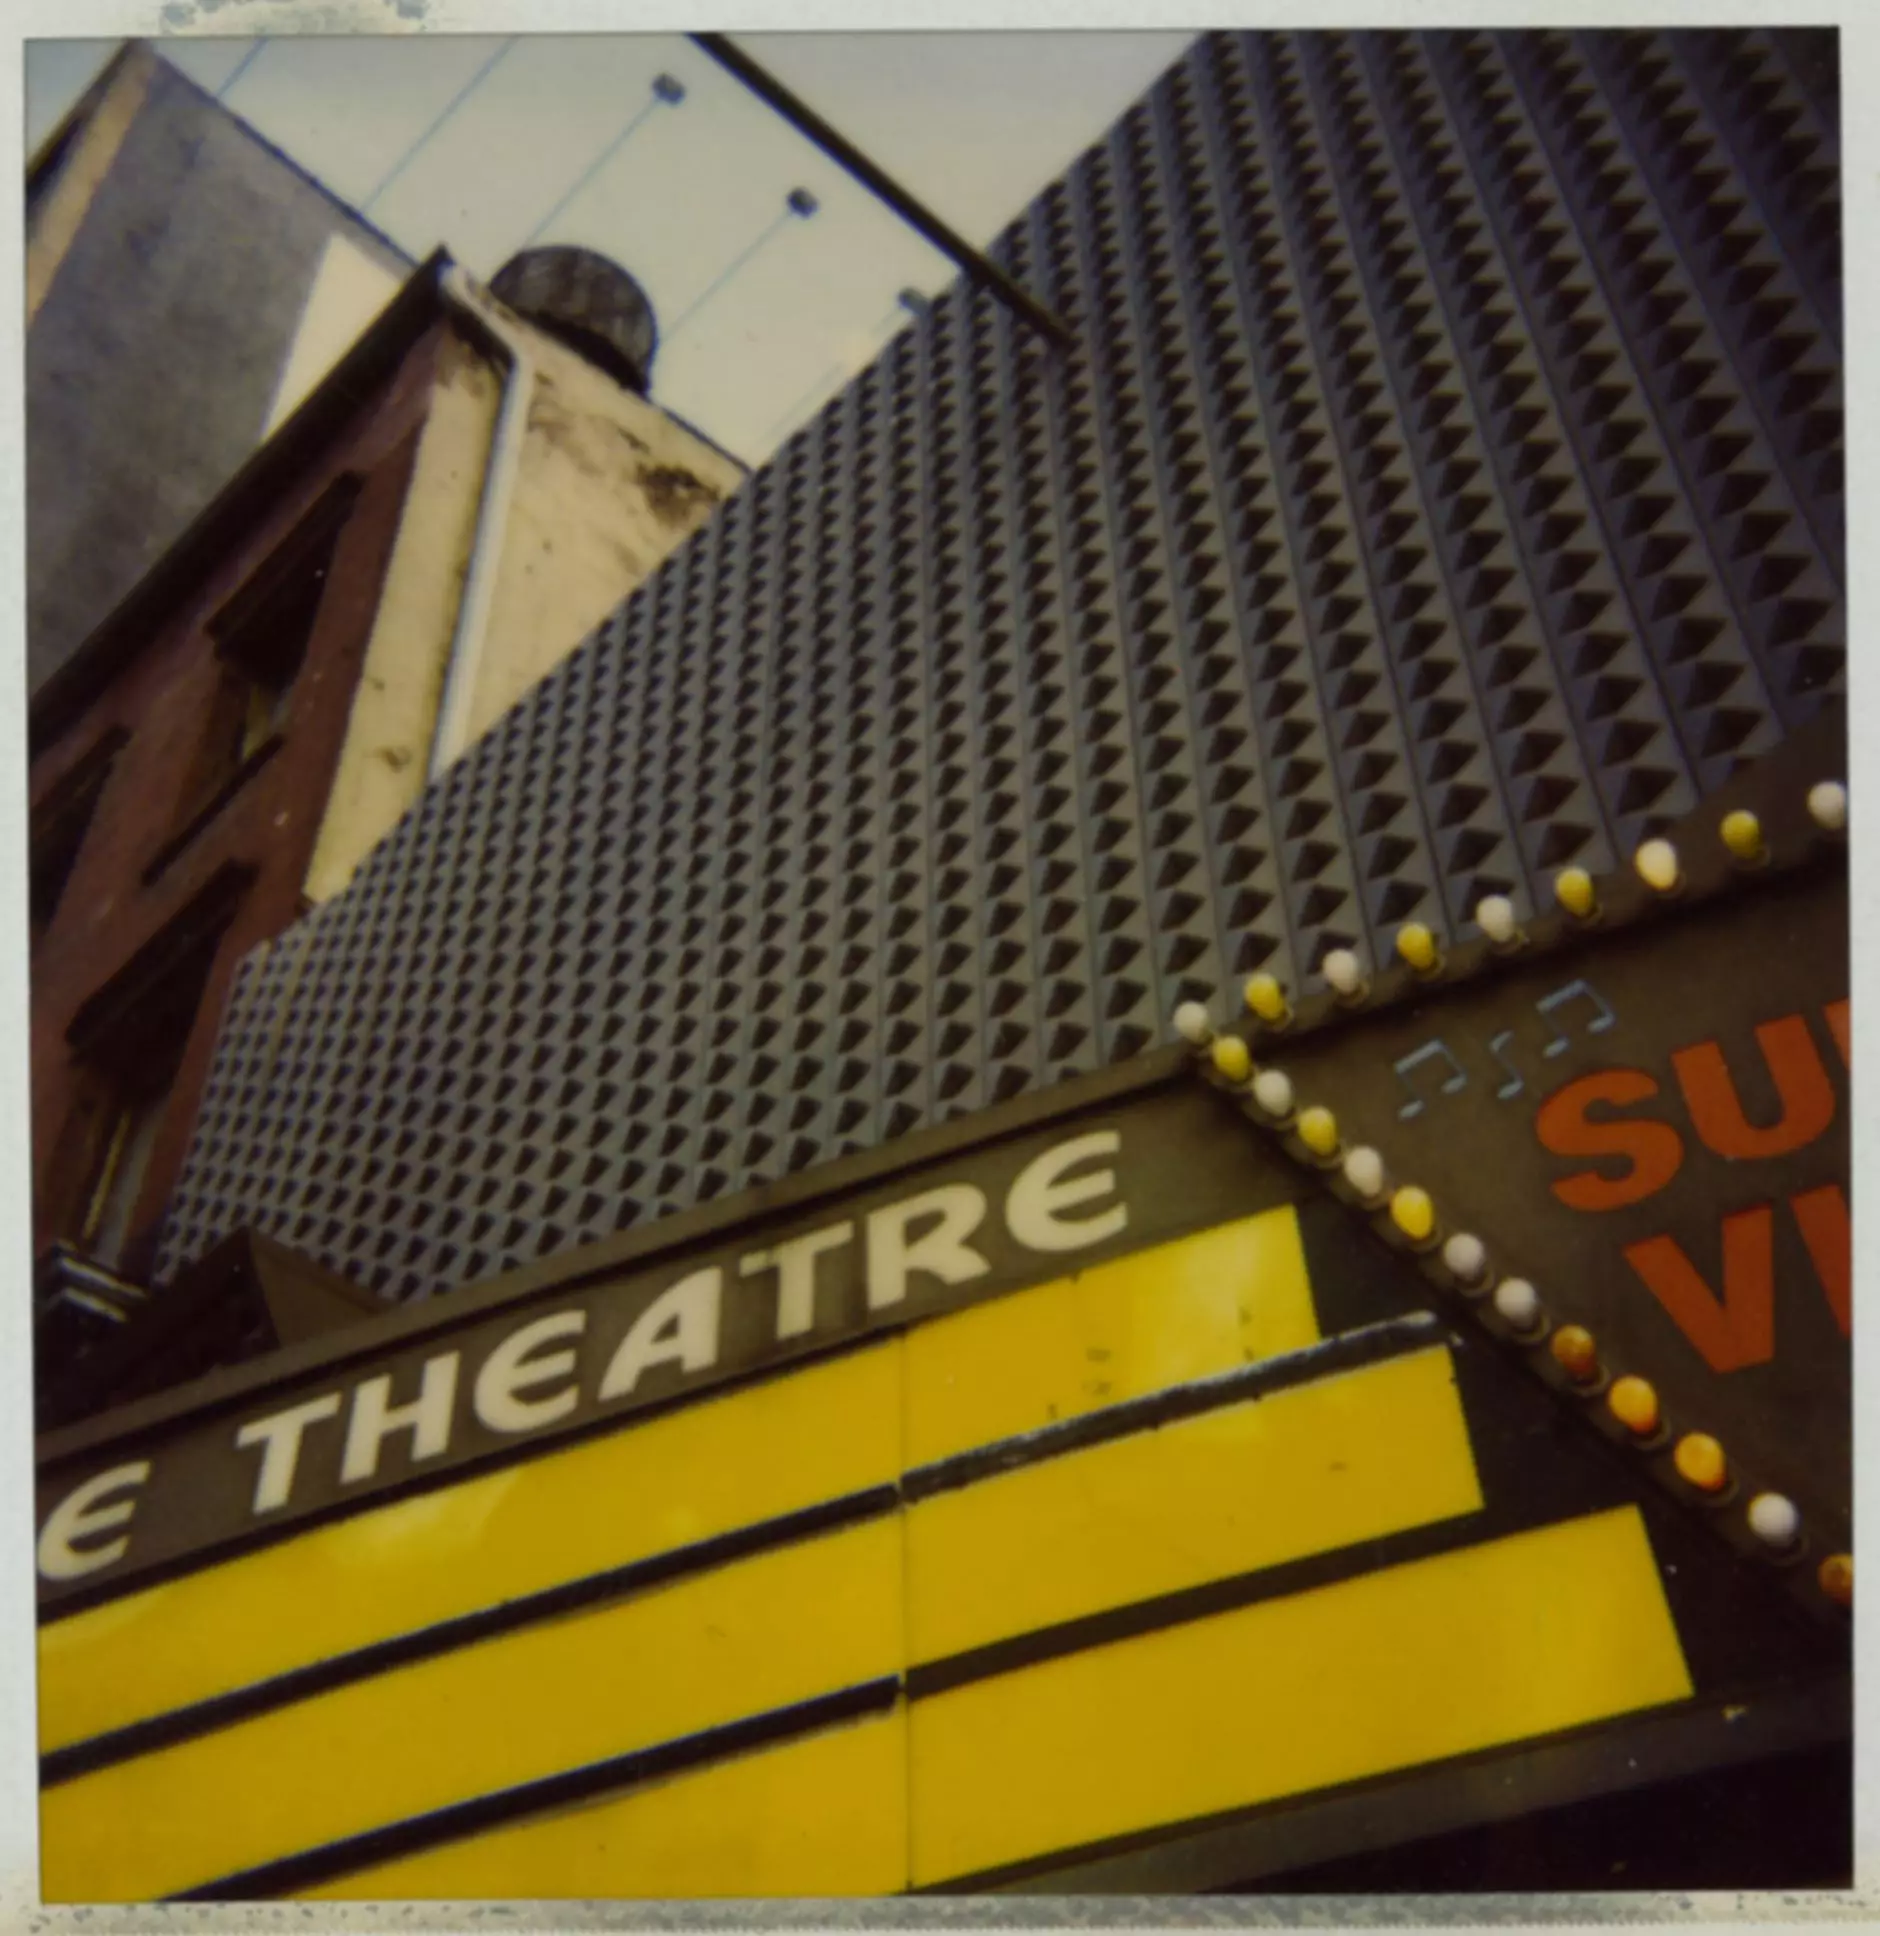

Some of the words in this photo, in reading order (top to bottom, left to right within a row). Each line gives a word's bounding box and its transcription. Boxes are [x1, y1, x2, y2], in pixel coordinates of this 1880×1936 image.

[1535, 999, 1850, 1212] SU
[36, 1461, 150, 1581] E
[235, 1130, 1128, 1516] THEATRE
